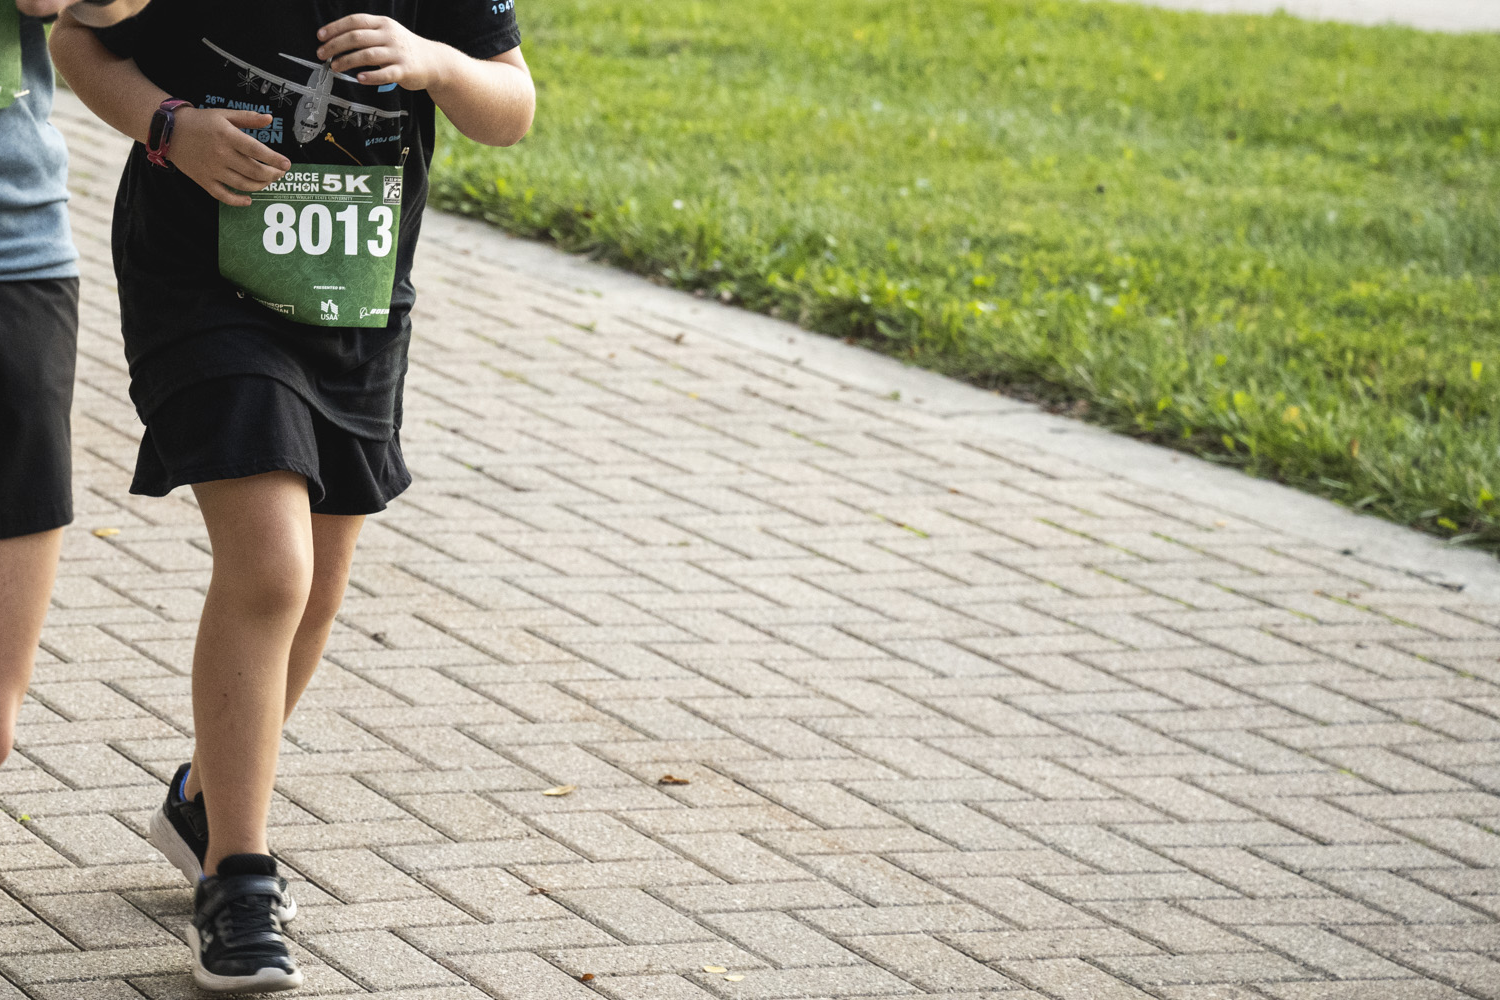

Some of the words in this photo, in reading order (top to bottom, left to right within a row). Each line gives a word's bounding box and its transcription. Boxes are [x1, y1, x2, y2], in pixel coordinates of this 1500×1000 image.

[205, 94, 225, 105] 26TH
[227, 99, 273, 114] ANNUAL
[281, 172, 319, 182] ORCE
[321, 173, 372, 194] 5K
[261, 182, 320, 193] ARATHON
[262, 203, 394, 258] 8013
[320, 313, 338, 321] USAA
